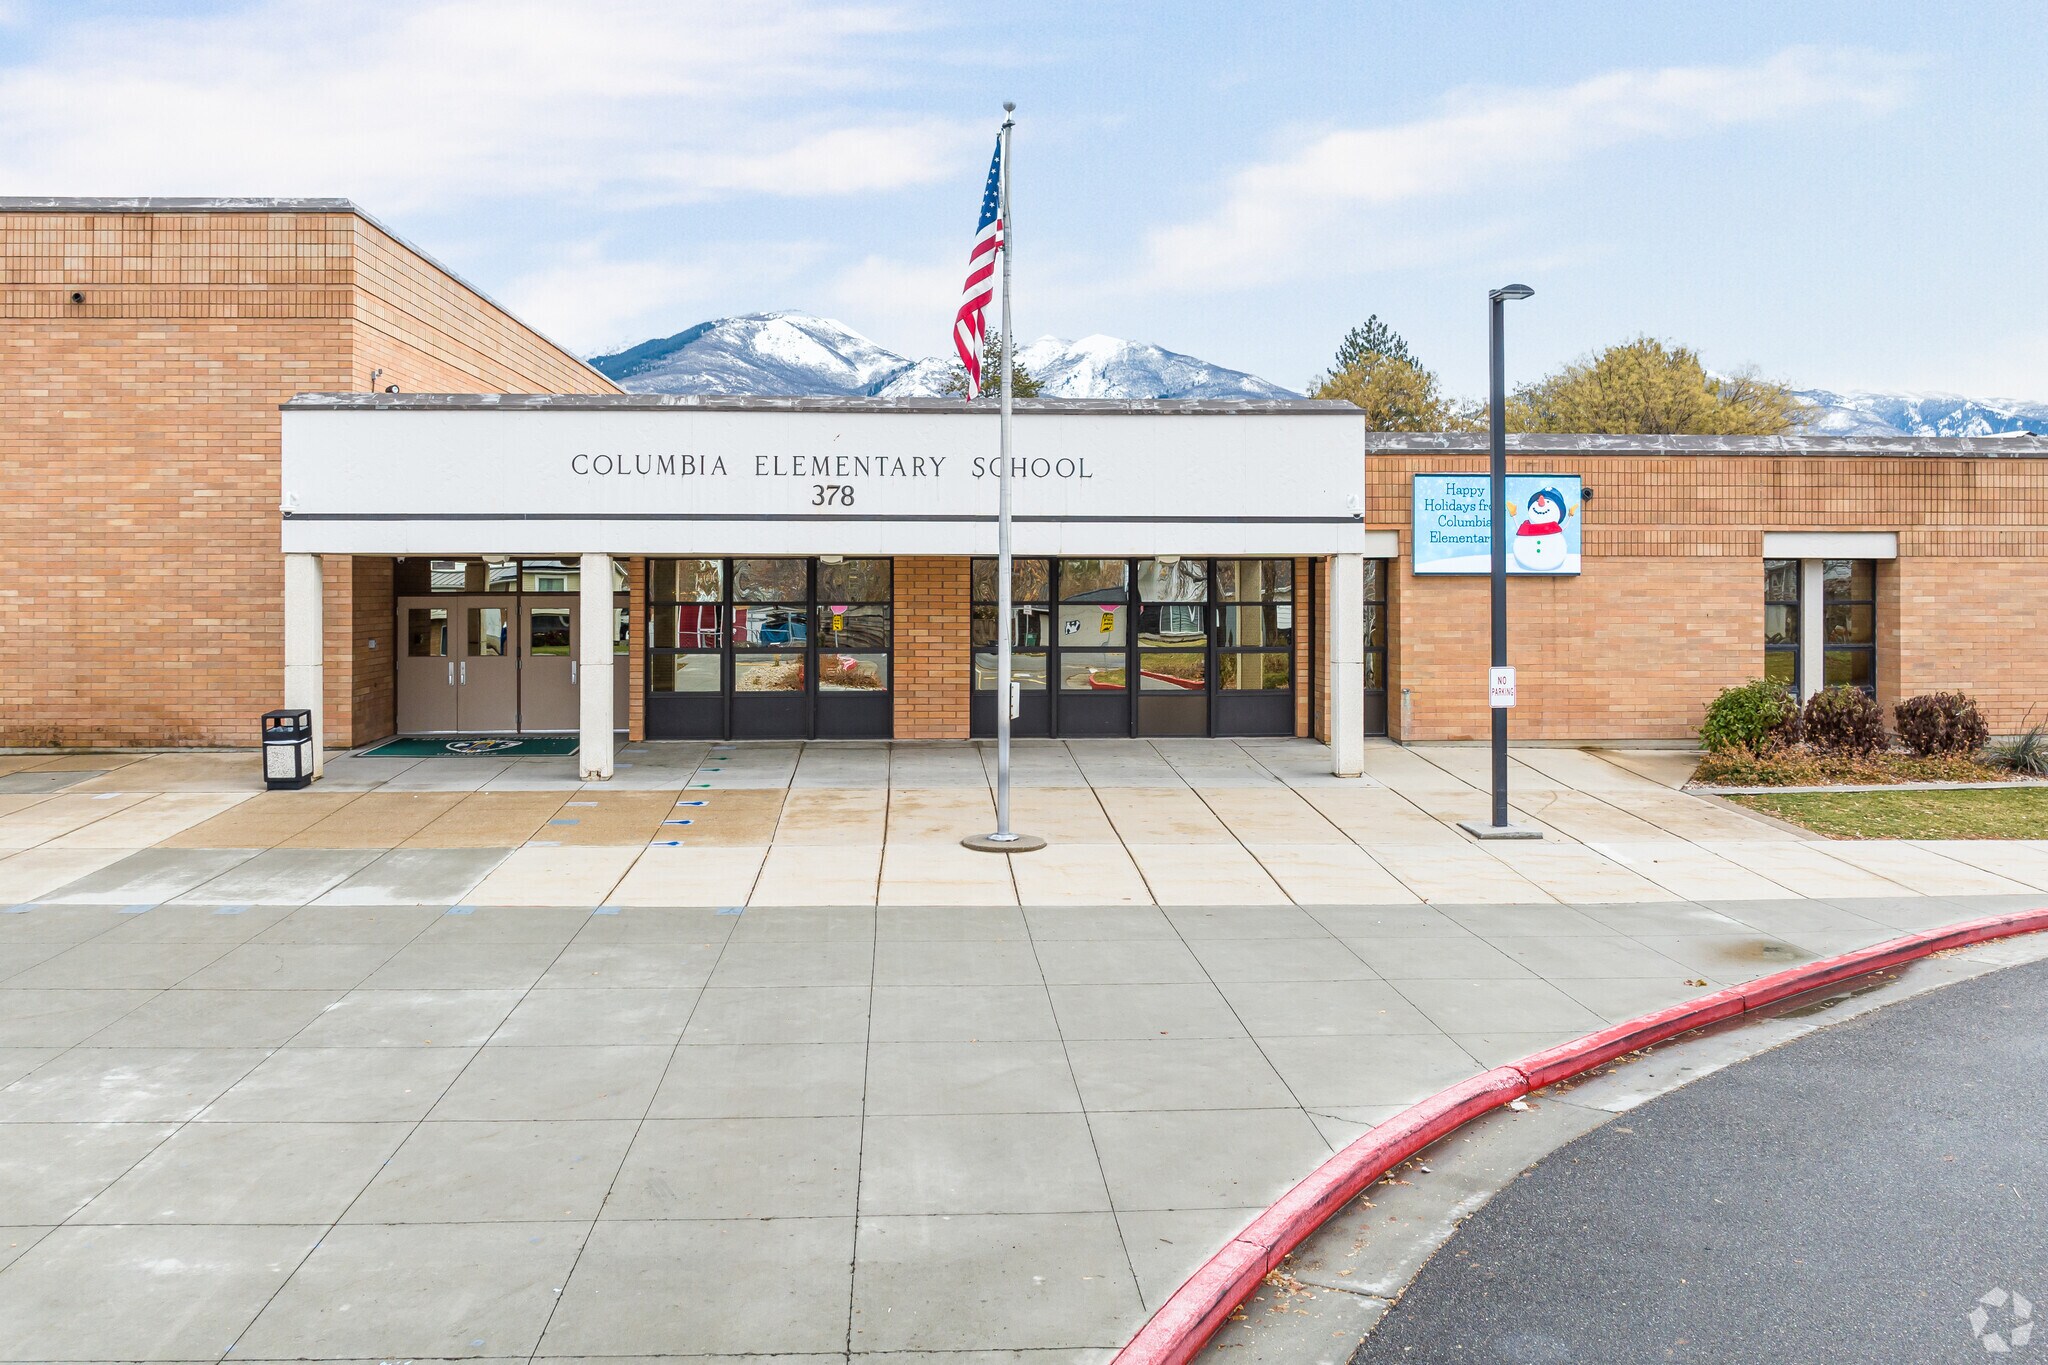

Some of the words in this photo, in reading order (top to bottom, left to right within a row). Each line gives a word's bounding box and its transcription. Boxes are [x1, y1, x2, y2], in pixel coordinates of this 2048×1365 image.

[571, 454, 728, 477] COLUMBIA
[754, 455, 946, 478] ELEMENTARY
[971, 456, 1093, 479] SCHOOL
[811, 484, 855, 507] 378
[1446, 483, 1485, 497] Happy
[1424, 499, 1476, 513] Holidays
[1478, 498, 1493, 511] fr
[1438, 515, 1492, 528] Columbia
[1430, 531, 1491, 544] Elementar
[1497, 675, 1507, 685] NO
[1491, 687, 1514, 697] PARKING
